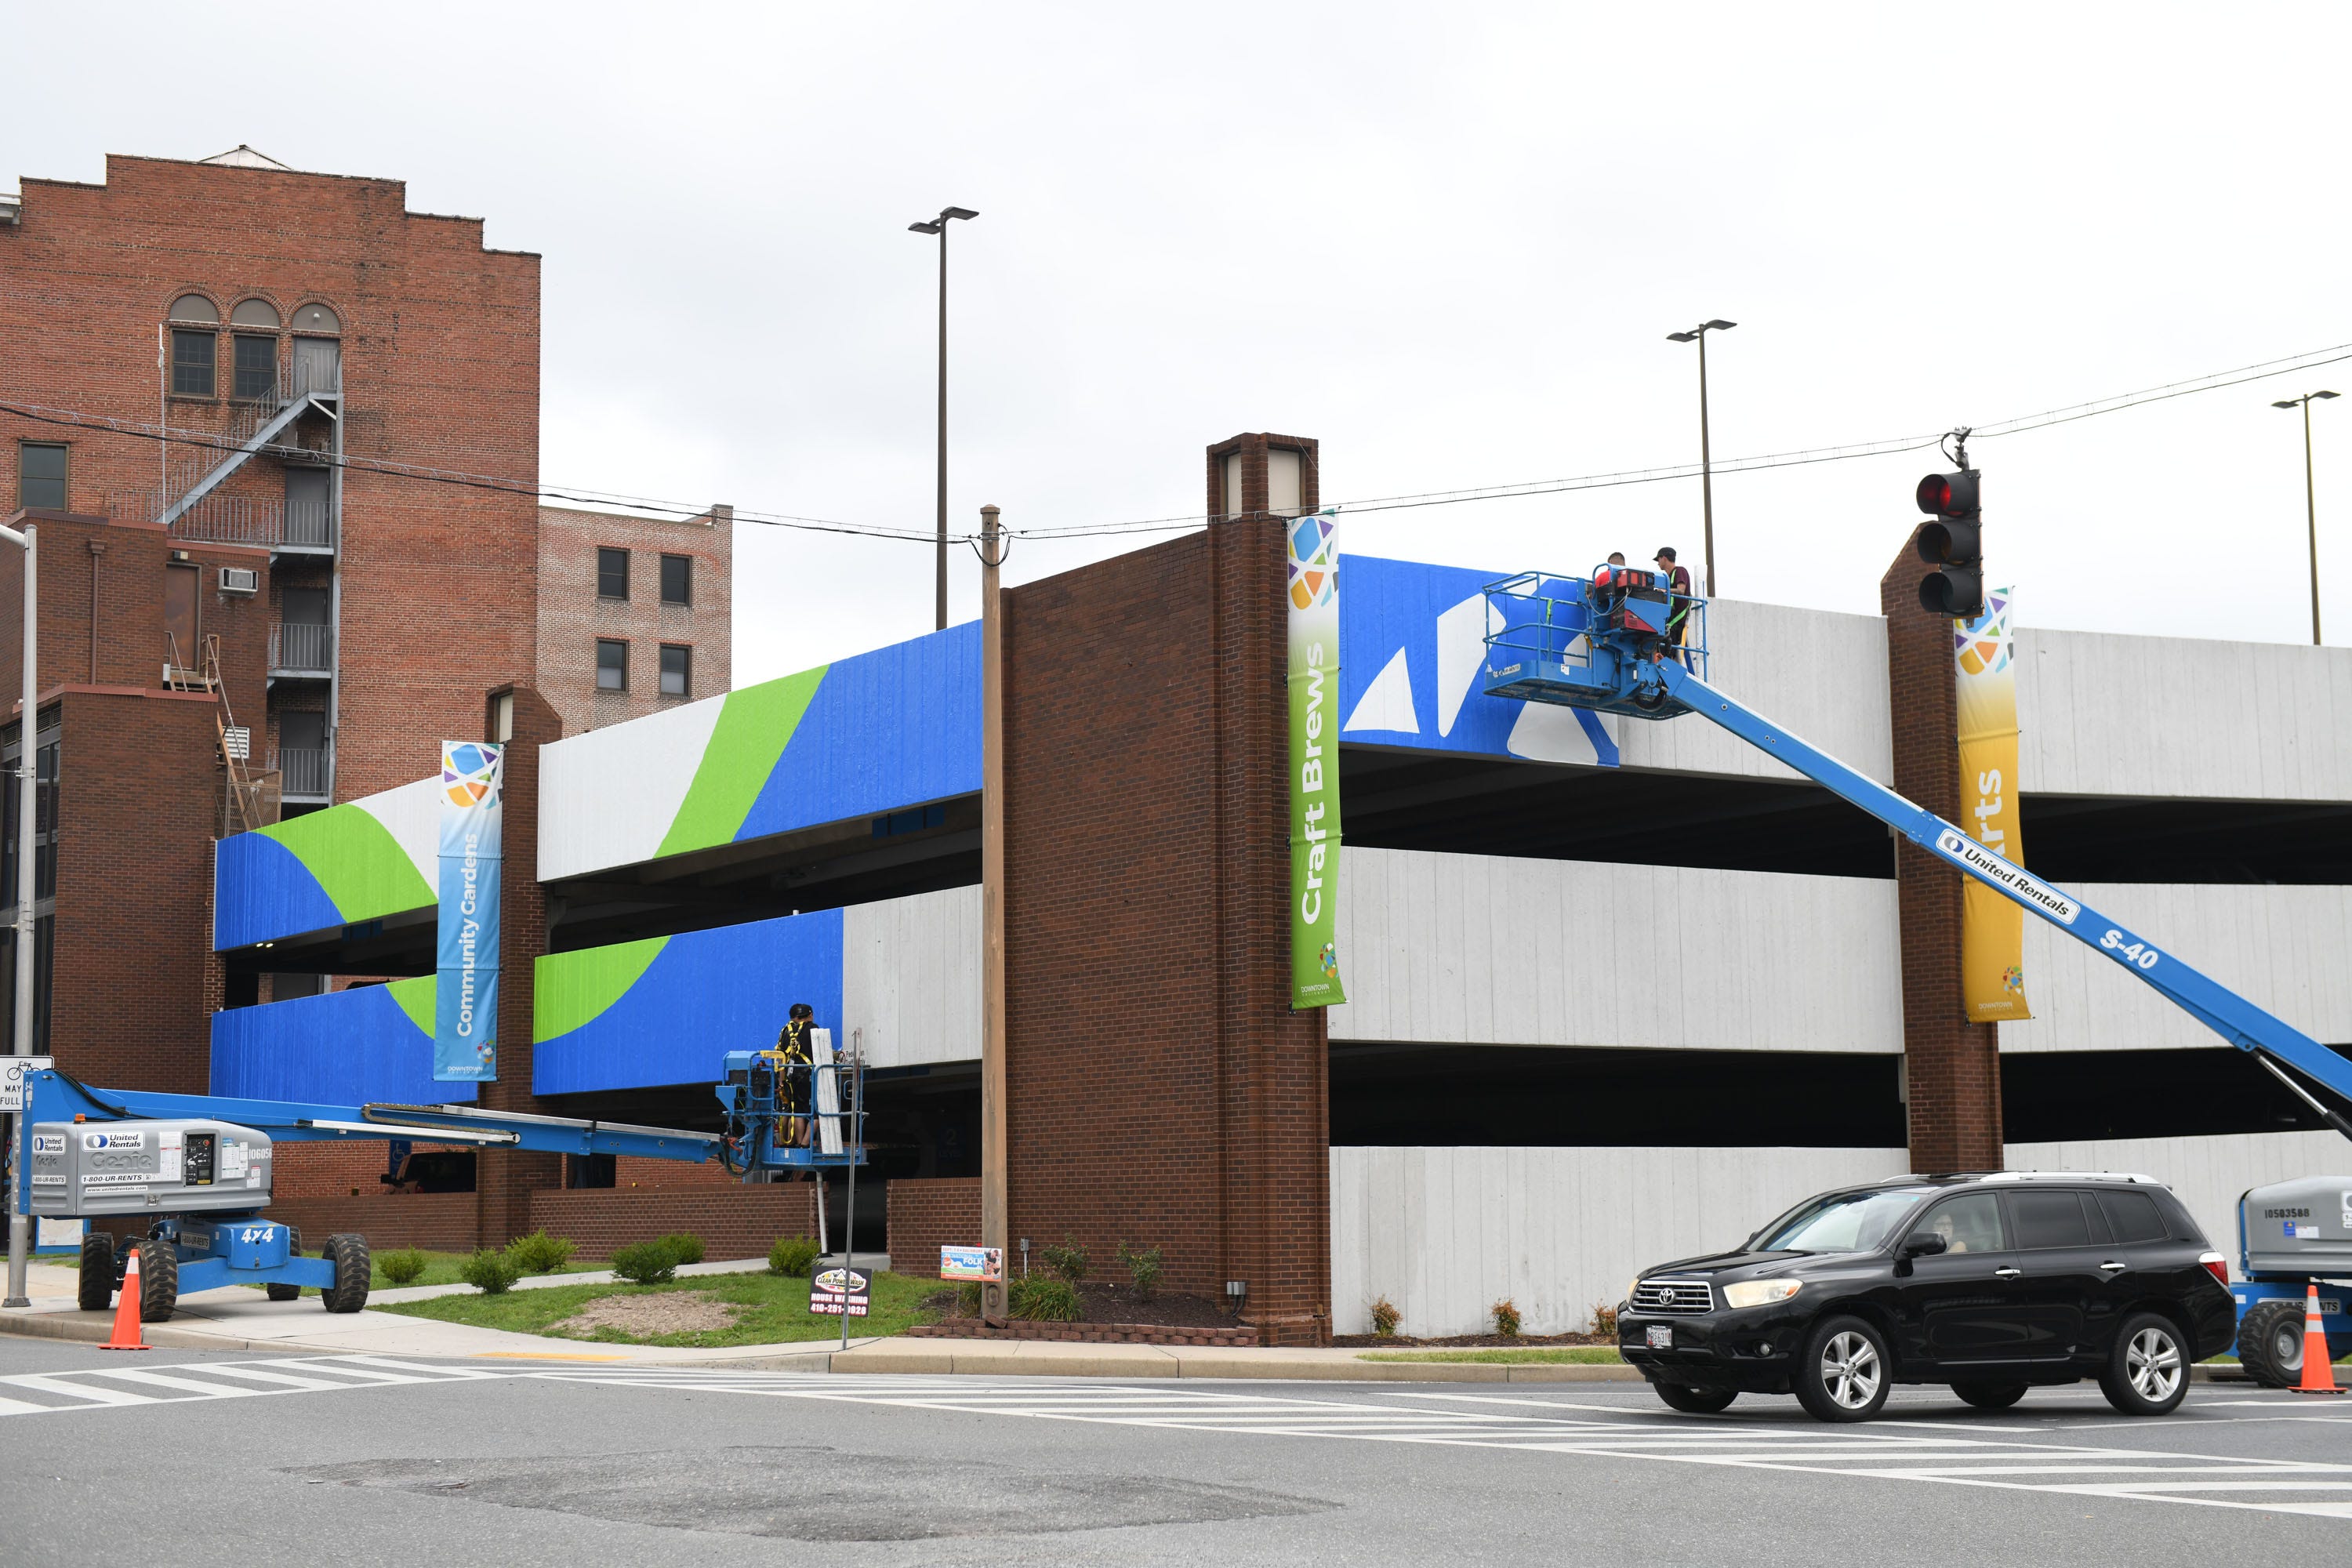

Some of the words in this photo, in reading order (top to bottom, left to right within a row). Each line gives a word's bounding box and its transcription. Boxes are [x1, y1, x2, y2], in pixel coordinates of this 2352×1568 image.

[1301, 641, 1325, 794] Brews
[1975, 768, 2005, 855] rts
[460, 833, 477, 914] Gardens
[1301, 801, 1326, 926] Craft
[1964, 848, 2016, 884] United
[2013, 877, 2069, 916] Rentals
[457, 909, 479, 1037] Community
[2100, 929, 2158, 968] S-40
[1301, 983, 1330, 993] DOWNTOWN
[5, 1084, 22, 1093] MAY
[90, 1151, 152, 1171] Genie
[241, 1228, 274, 1243] 4x4
[811, 1293, 833, 1302] HOUSE
